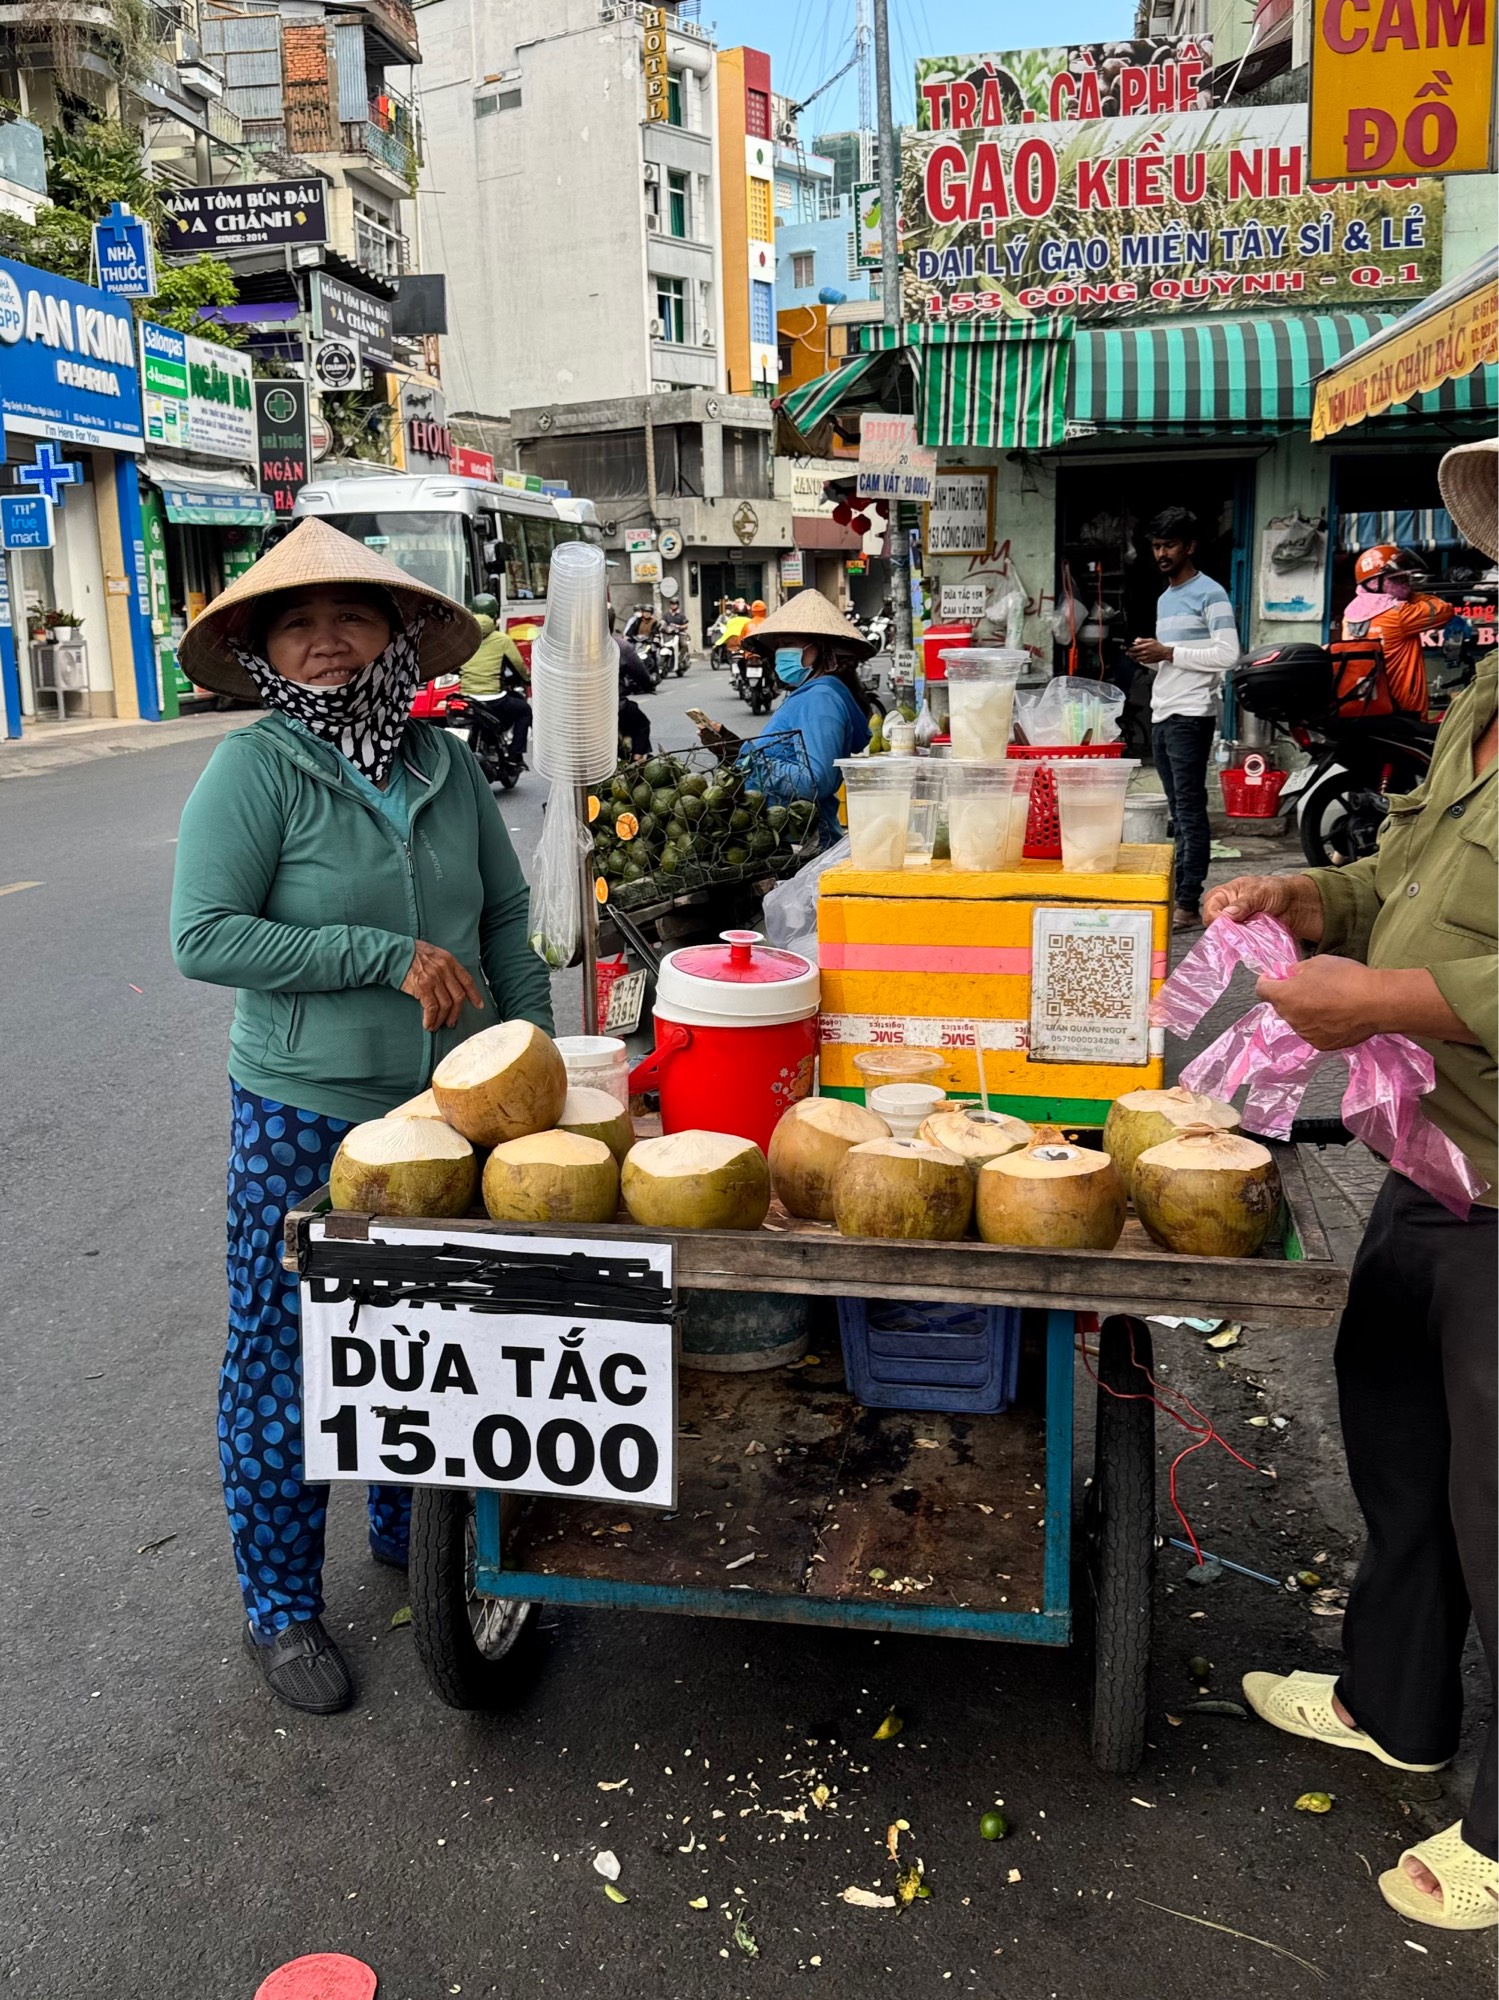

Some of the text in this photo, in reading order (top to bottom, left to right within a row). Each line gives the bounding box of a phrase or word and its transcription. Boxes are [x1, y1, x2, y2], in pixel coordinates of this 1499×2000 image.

[646, 11, 662, 119] HOTEL
[922, 61, 1003, 130] TRÀ
[1050, 53, 1102, 121] CÀ
[1120, 43, 1203, 116] PHÊ
[1343, 71, 1458, 172] ĐỒ
[926, 139, 1057, 236] GẠO
[1077, 133, 1206, 210] KIỀU
[205, 191, 242, 211] TÔM
[247, 188, 280, 207] BÚN
[284, 185, 321, 208] ĐẬU
[191, 209, 292, 233] A CHẢNH
[246, 233, 268, 242] 2014
[918, 205, 1425, 286] ĐẠI LÝ GẠO MIỀN TÂY SỈ & LẺ
[107, 242, 137, 262] NHÀ
[101, 261, 147, 282] THUỐC
[107, 283, 144, 293] PHARMA
[926, 291, 1003, 315] 153
[1350, 264, 1422, 287] Q.1
[26, 290, 134, 368] AN KIM
[145, 327, 184, 358] Salonpas
[1371, 360, 1393, 406] TÂN
[1395, 339, 1433, 395] CHÂU
[1435, 310, 1466, 376] BẮC
[56, 359, 121, 398] PHARMA
[45, 424, 100, 443] I'm Here For You
[263, 456, 304, 481] NGÂN
[860, 473, 880, 492] CAM
[883, 467, 900, 493] VẮT
[12, 504, 30, 516] TH
[274, 486, 295, 510] HÀ
[11, 517, 37, 529] true
[11, 531, 41, 544] mart
[943, 606, 957, 615] CAM
[1454, 601, 1495, 622] ráng
[418, 829, 444, 880] NEW MODEL
[870, 1031, 904, 1043] SMC
[941, 1023, 974, 1033] ogistics
[942, 1033, 975, 1046] SMC
[1070, 1026, 1101, 1034] QUANG
[1103, 1027, 1127, 1035] NGOT
[331, 1324, 648, 1407] DỪA TẮC
[320, 1404, 659, 1493] 15.000
